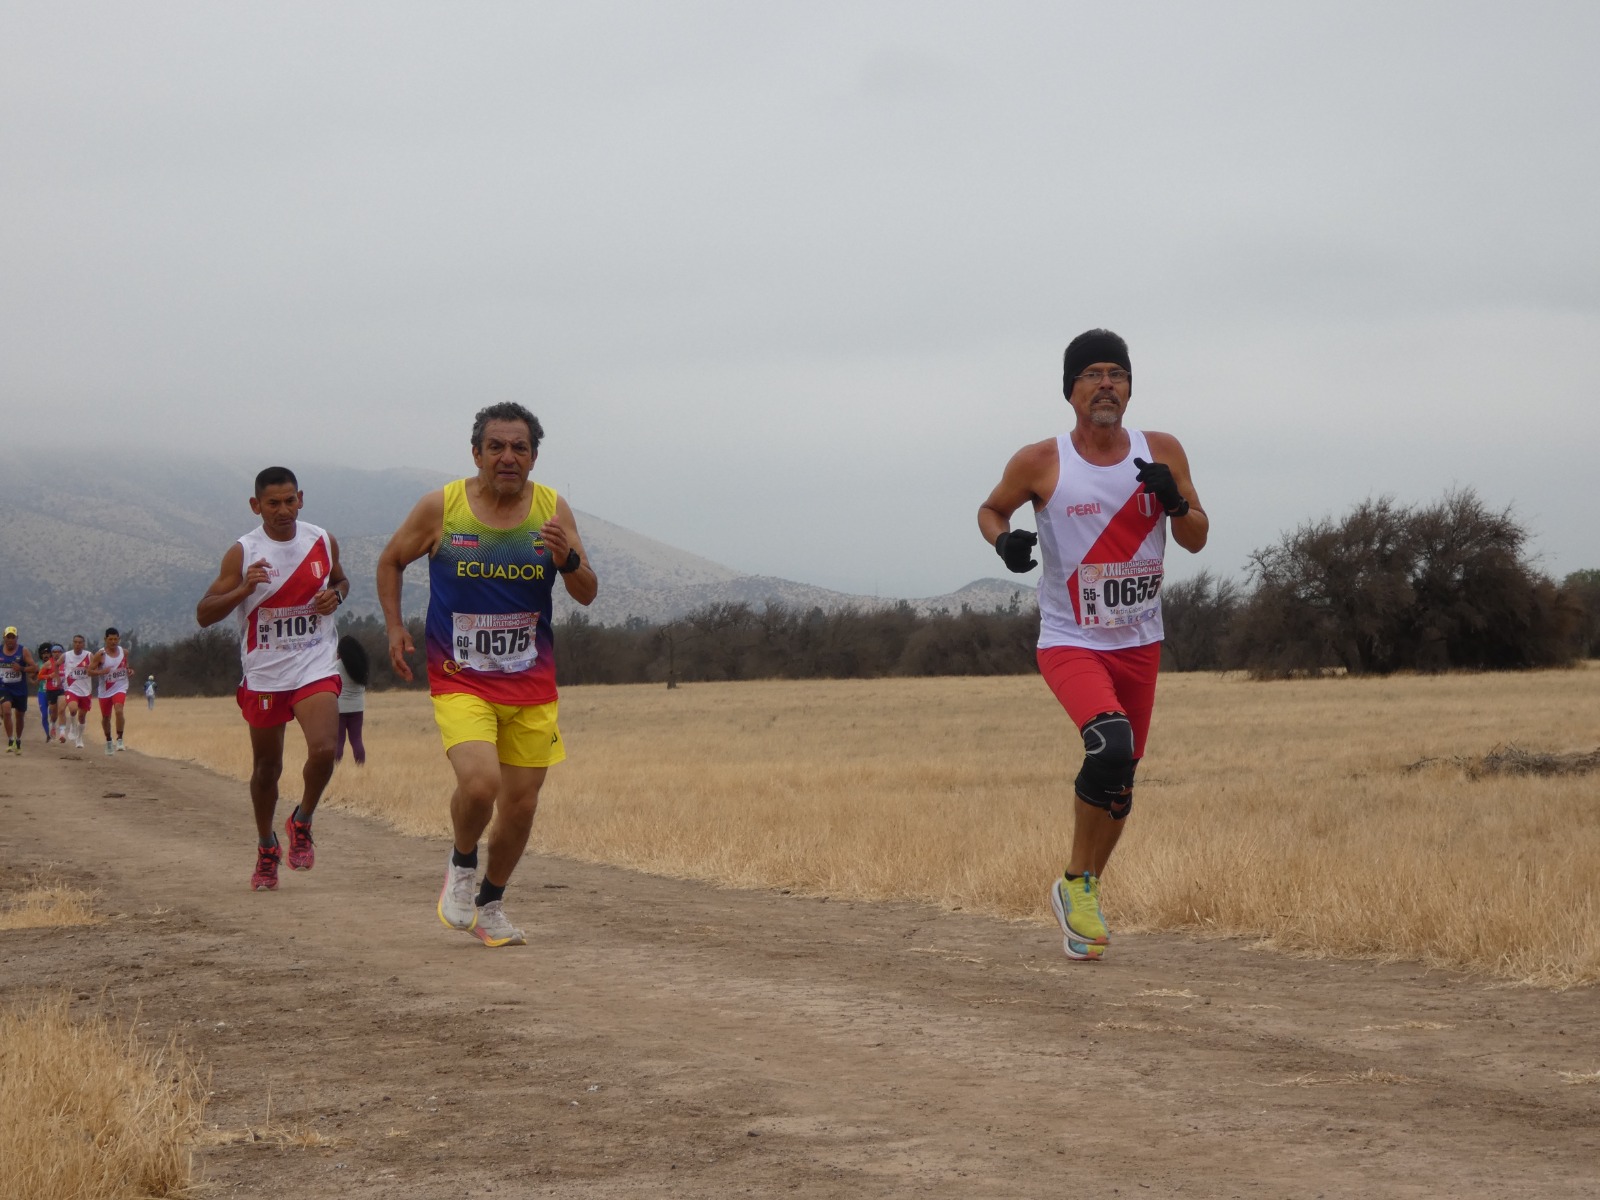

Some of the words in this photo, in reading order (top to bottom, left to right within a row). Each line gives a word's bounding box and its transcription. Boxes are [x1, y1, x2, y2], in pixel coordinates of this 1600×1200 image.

[1066, 503, 1101, 517] PERU
[457, 561, 545, 580] ECUADOR
[1102, 562, 1121, 577] XXII
[1121, 566, 1148, 576] ATLETISMO
[1083, 588, 1100, 601] 55-
[1103, 574, 1162, 608] 0655
[1087, 604, 1096, 615] M
[274, 615, 317, 637] 1103
[475, 614, 493, 627] XXII
[493, 619, 519, 627] ATLETISMO
[261, 634, 268, 643] M
[456, 636, 473, 647] 60-
[476, 627, 529, 656] 0575
[460, 650, 468, 660] M
